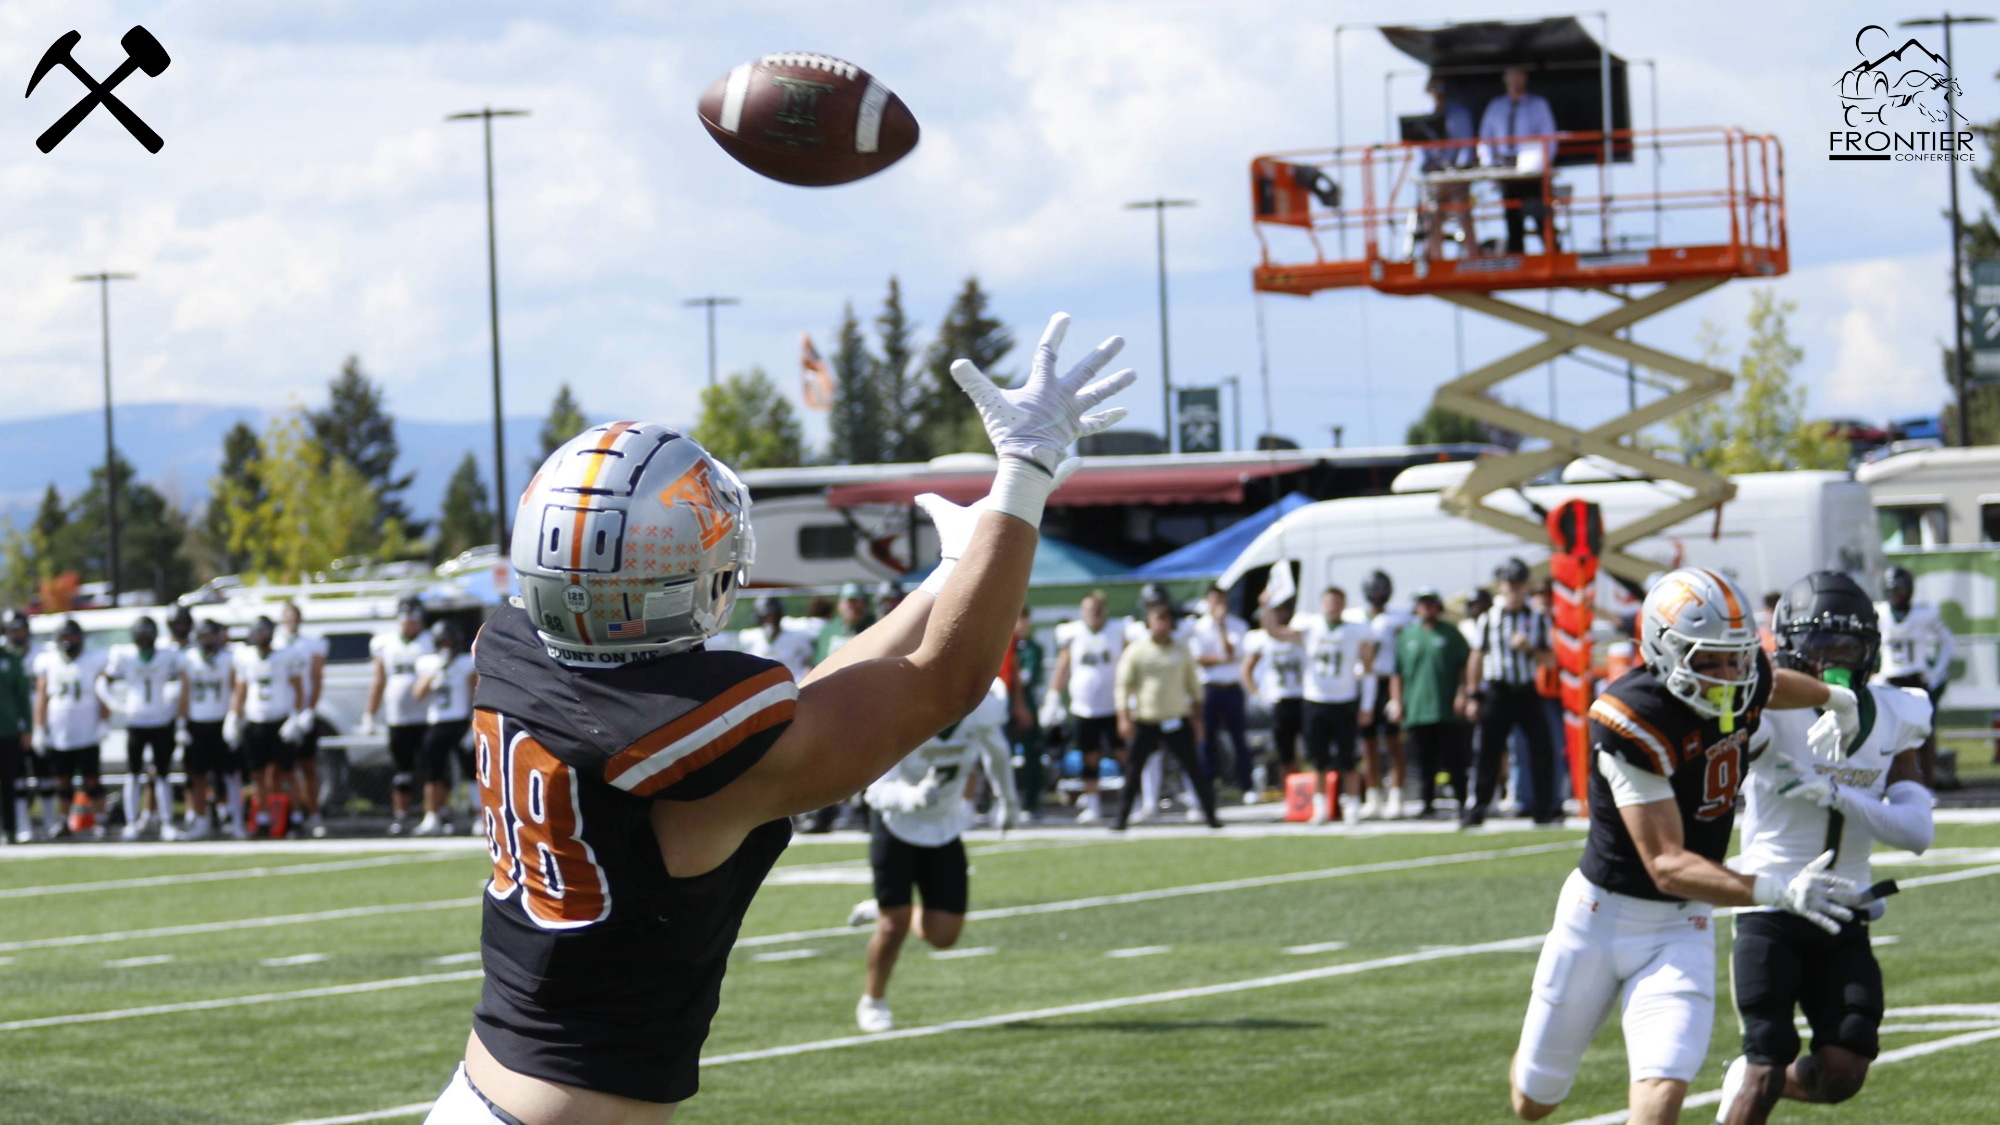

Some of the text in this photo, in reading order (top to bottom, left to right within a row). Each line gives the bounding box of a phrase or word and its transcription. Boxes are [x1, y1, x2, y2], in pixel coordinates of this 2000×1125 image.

[566, 591, 585, 601] 125
[543, 613, 565, 633] 88
[599, 651, 627, 664] ON
[1694, 746, 1741, 822] 9
[473, 709, 612, 929] 88
